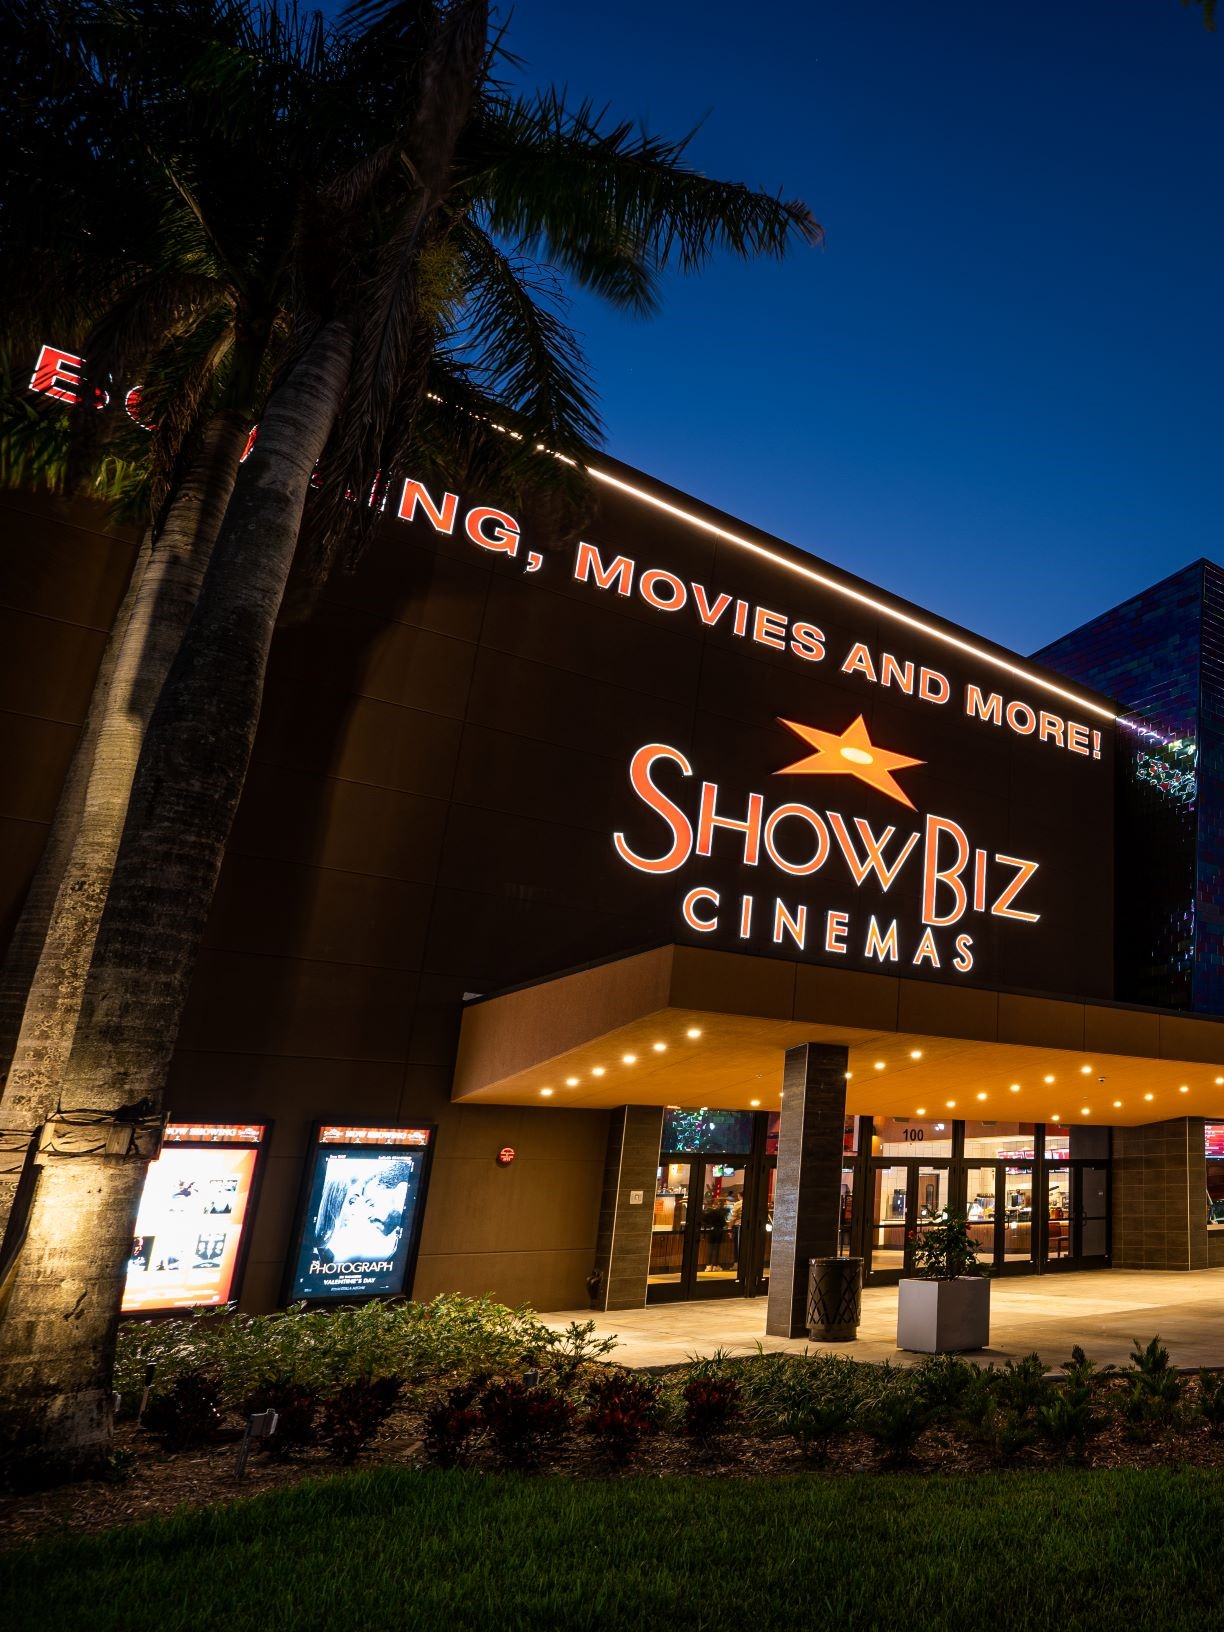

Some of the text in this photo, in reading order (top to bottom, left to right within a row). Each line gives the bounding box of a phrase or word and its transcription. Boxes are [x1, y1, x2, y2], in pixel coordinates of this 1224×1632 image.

[573, 540, 826, 661] MOVIES
[841, 642, 950, 704] AND
[965, 683, 1102, 759] MORE!
[682, 886, 975, 972] CINEMAS
[903, 1129, 924, 1141] 100
[309, 1261, 394, 1274] PHOTOGRAPH
